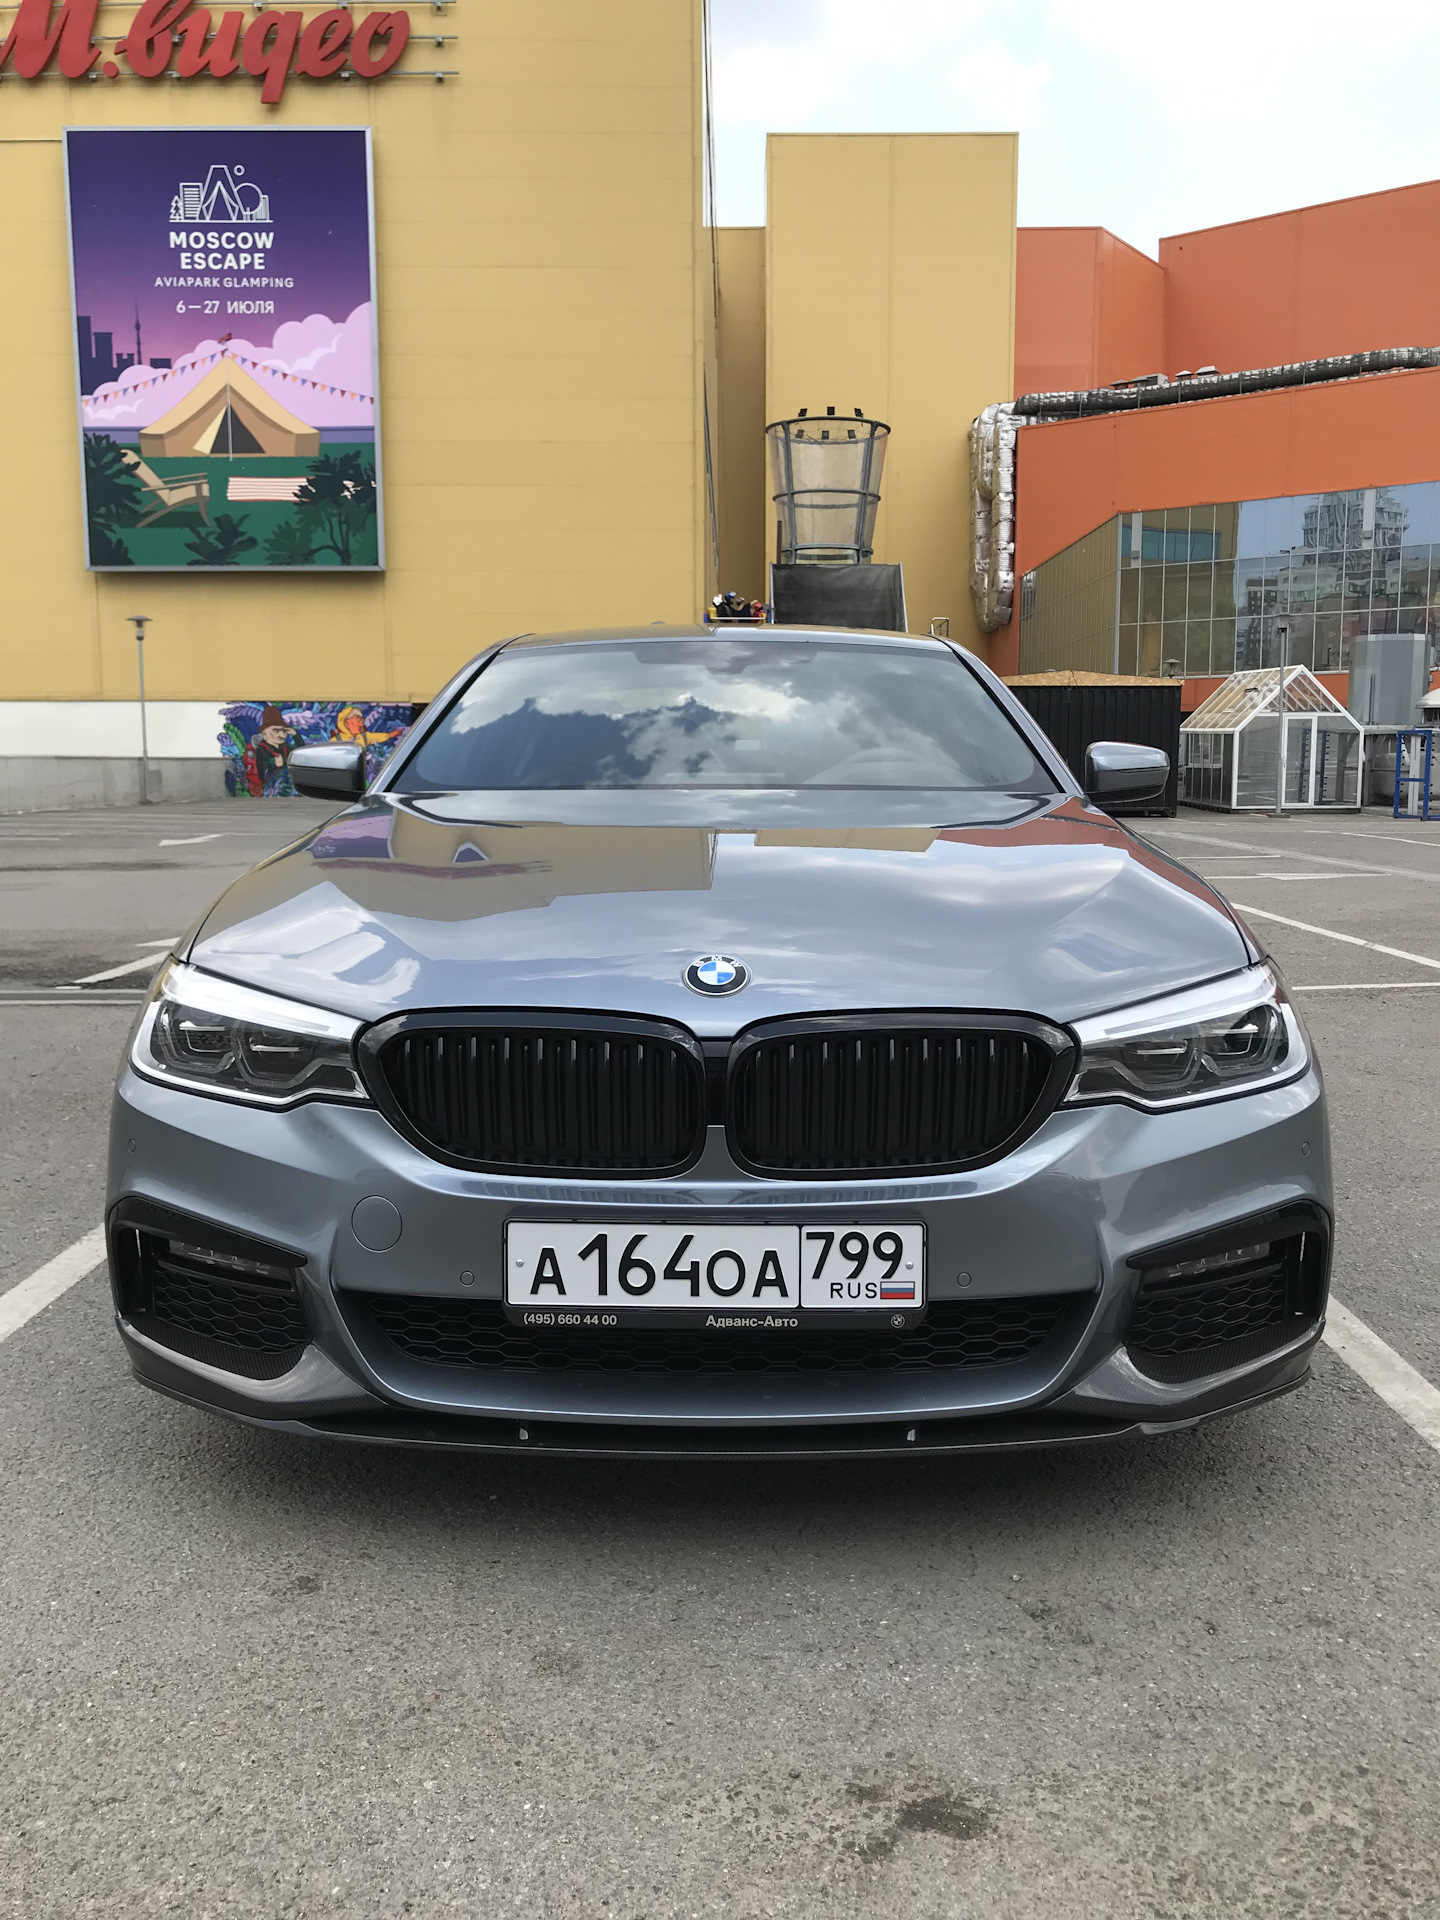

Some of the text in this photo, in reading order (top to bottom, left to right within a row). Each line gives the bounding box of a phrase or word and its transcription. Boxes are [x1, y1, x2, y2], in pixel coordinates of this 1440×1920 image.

[169, 231, 274, 249] MOSCOW
[180, 252, 265, 270] ESCAPE
[154, 276, 295, 289] AVIAPARK GLAMPING
[226, 300, 275, 314] ИЮЛЯ
[805, 1231, 903, 1279] 799
[829, 1282, 878, 1299] RUS
[523, 1313, 618, 1326] (495) 660 44 00
[705, 1314, 799, 1329] Адванс-Авто
